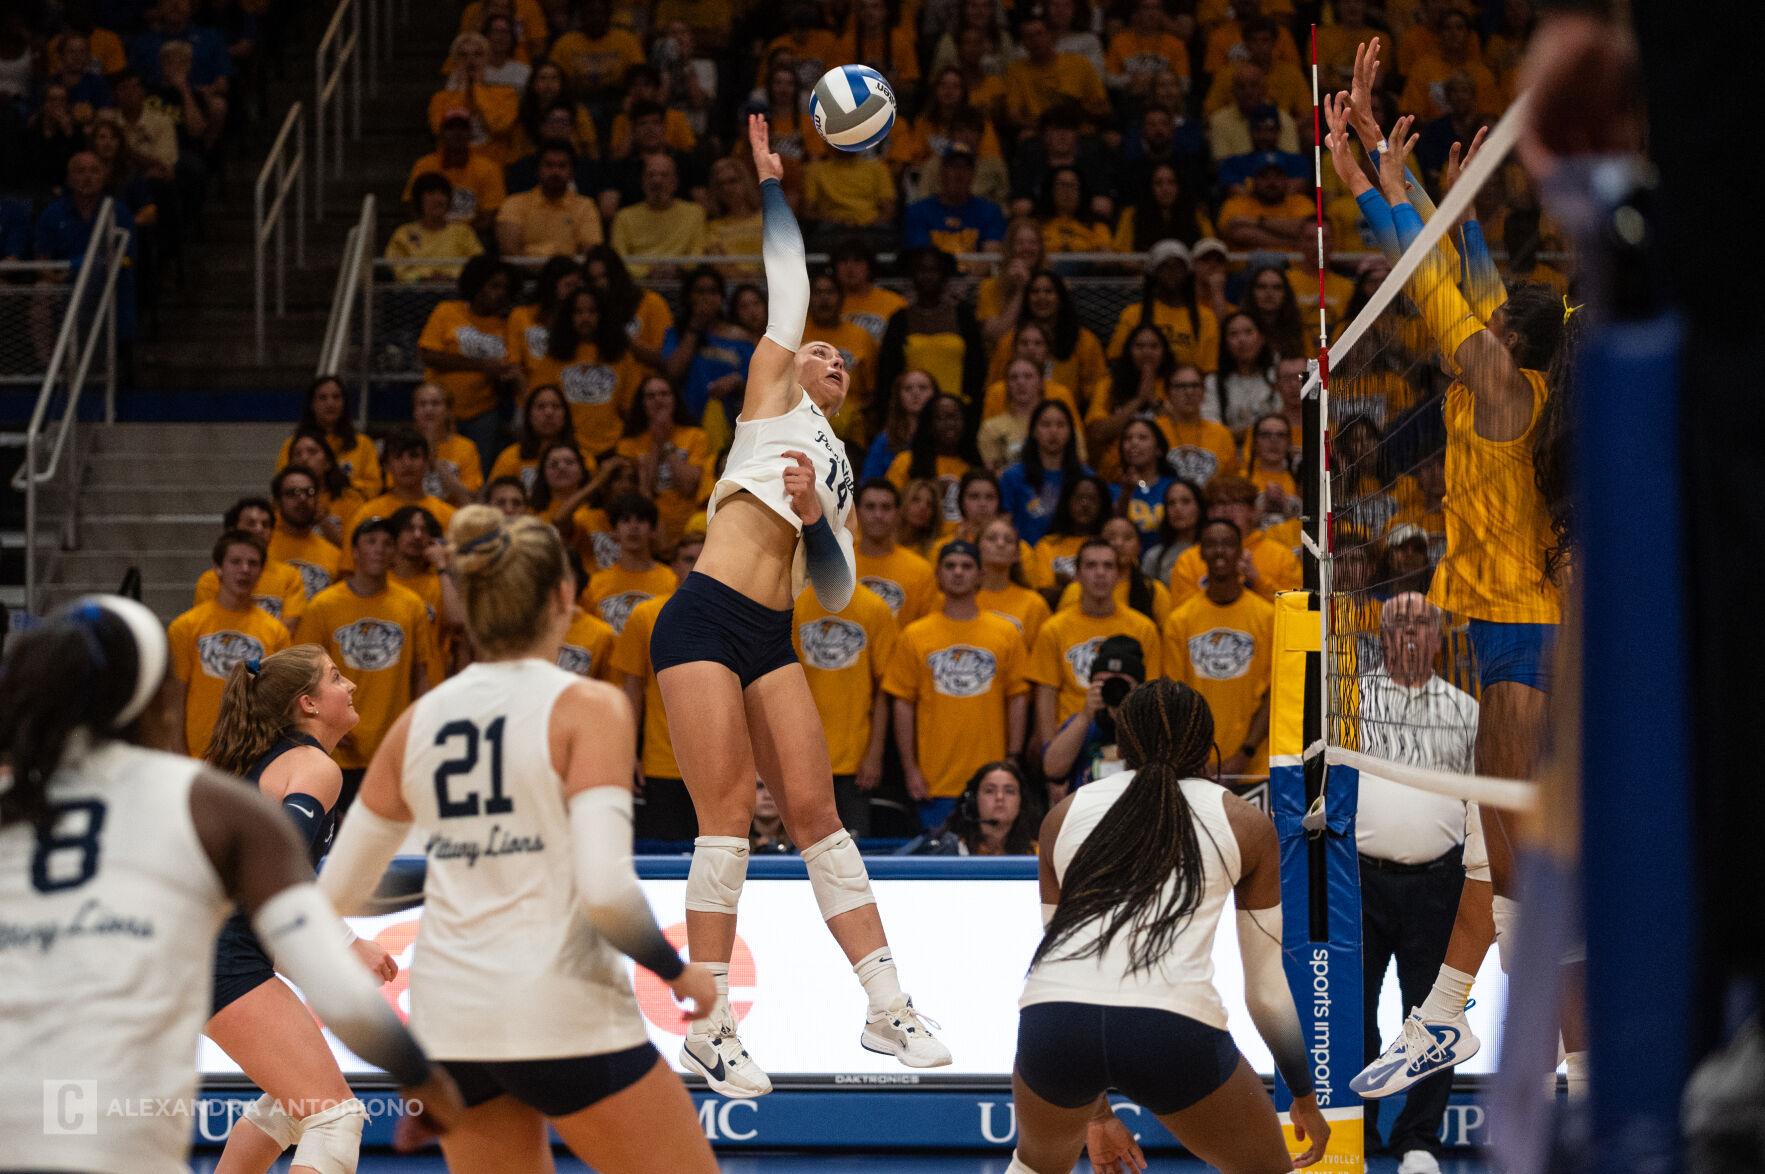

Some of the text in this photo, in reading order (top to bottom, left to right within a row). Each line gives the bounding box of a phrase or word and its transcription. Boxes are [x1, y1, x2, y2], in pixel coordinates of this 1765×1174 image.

[825, 457, 848, 514] 14
[434, 715, 514, 820] 21
[31, 797, 107, 895] 8
[1309, 949, 1334, 1106] sports imports
[835, 1074, 920, 1085] DAKTRONICS
